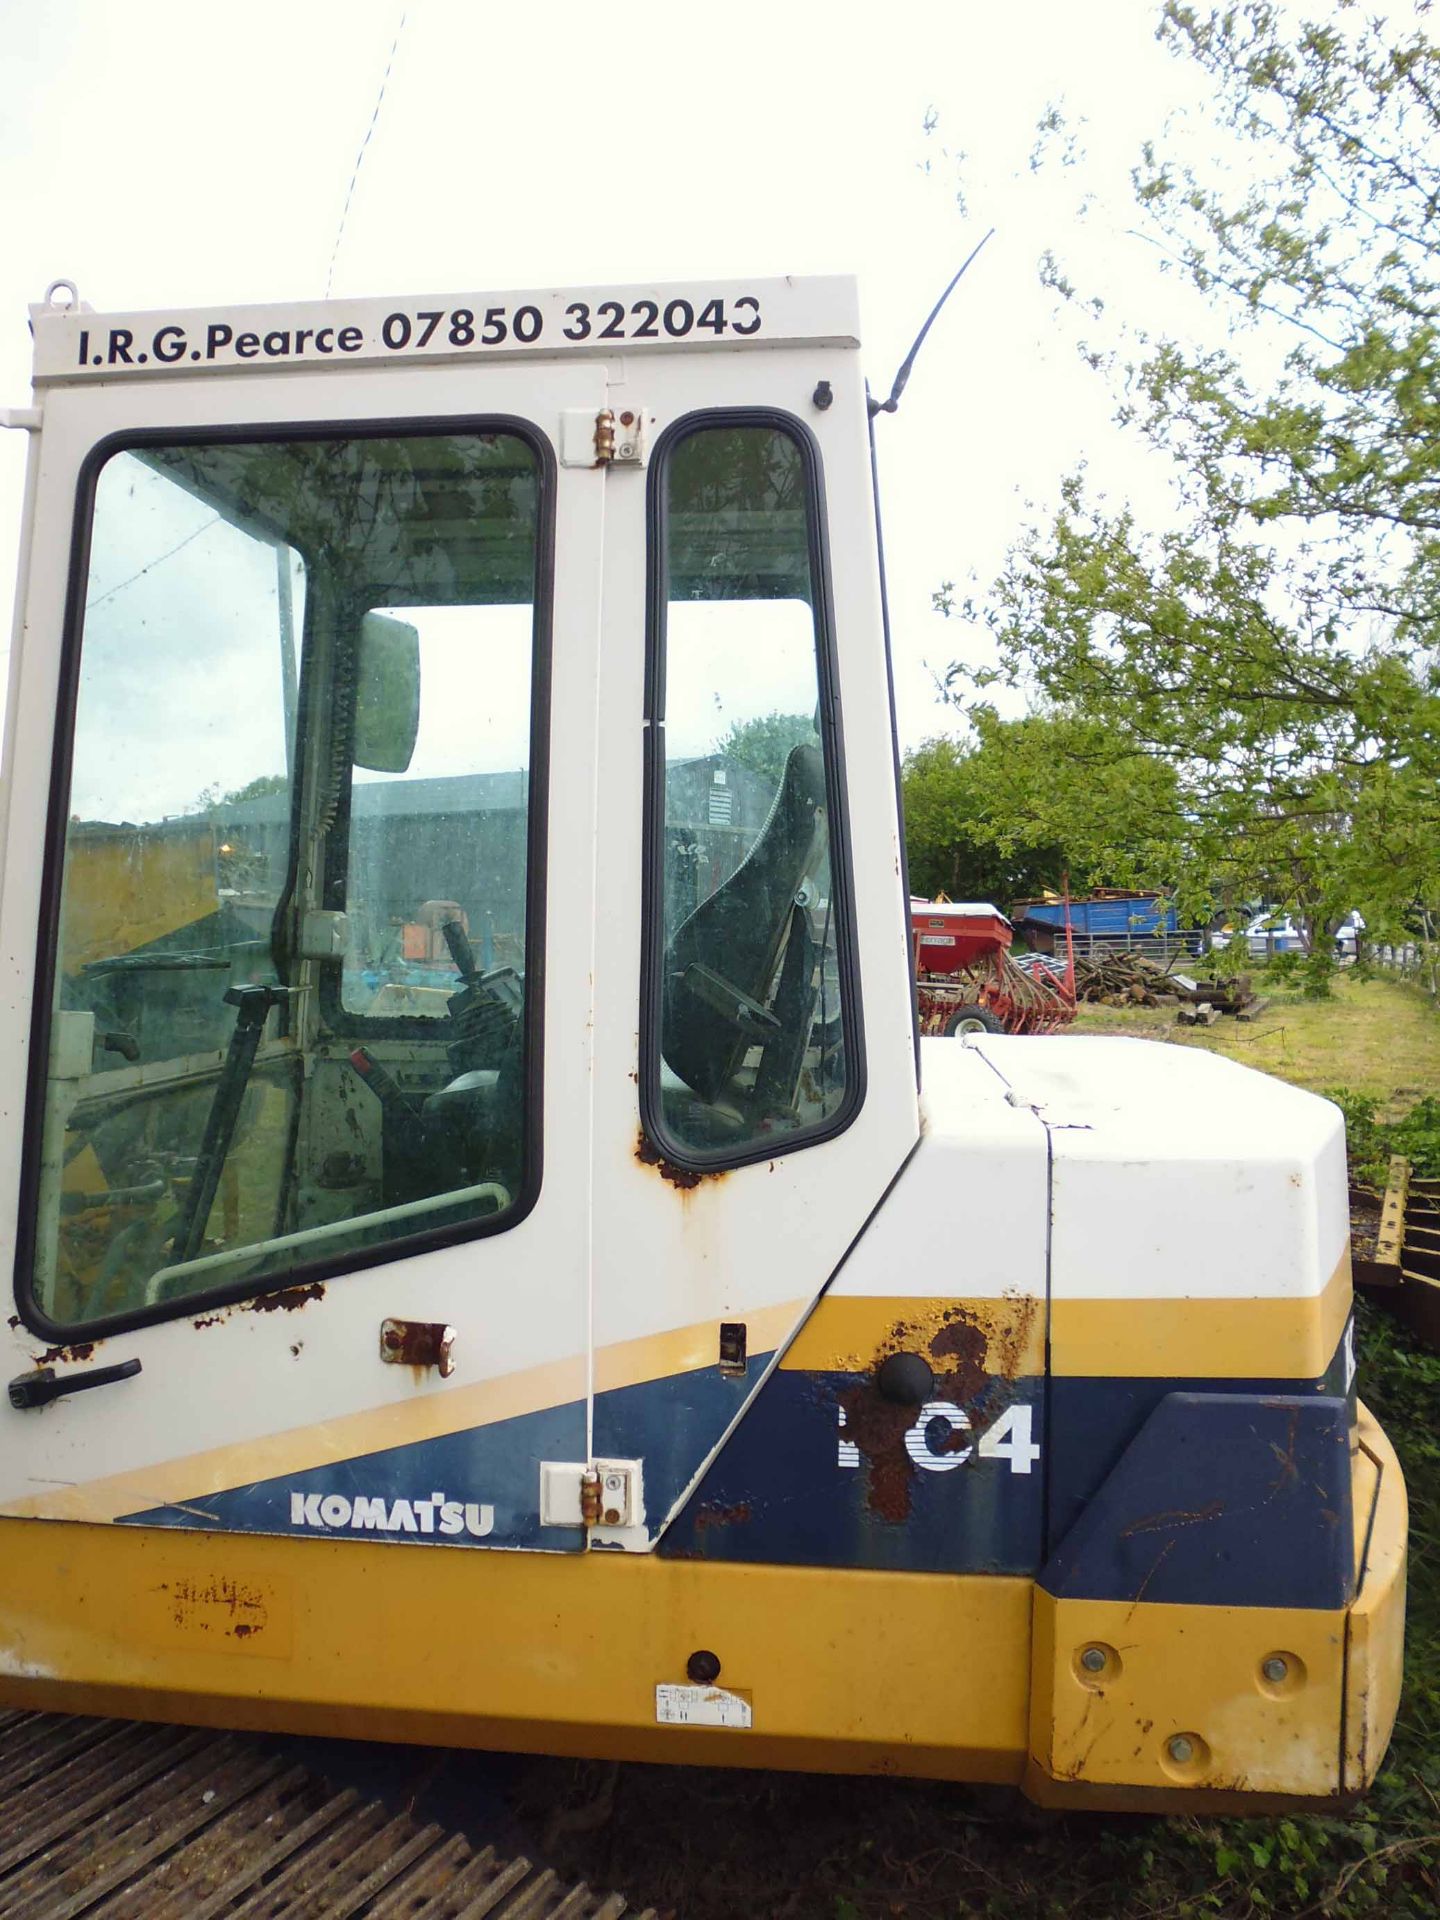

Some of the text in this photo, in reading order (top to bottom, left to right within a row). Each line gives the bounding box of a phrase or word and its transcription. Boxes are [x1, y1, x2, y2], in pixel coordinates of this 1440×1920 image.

[78, 296, 762, 366] I.R.G.Pearce 07850 322043
[290, 1491, 495, 1536] KOMATSU
